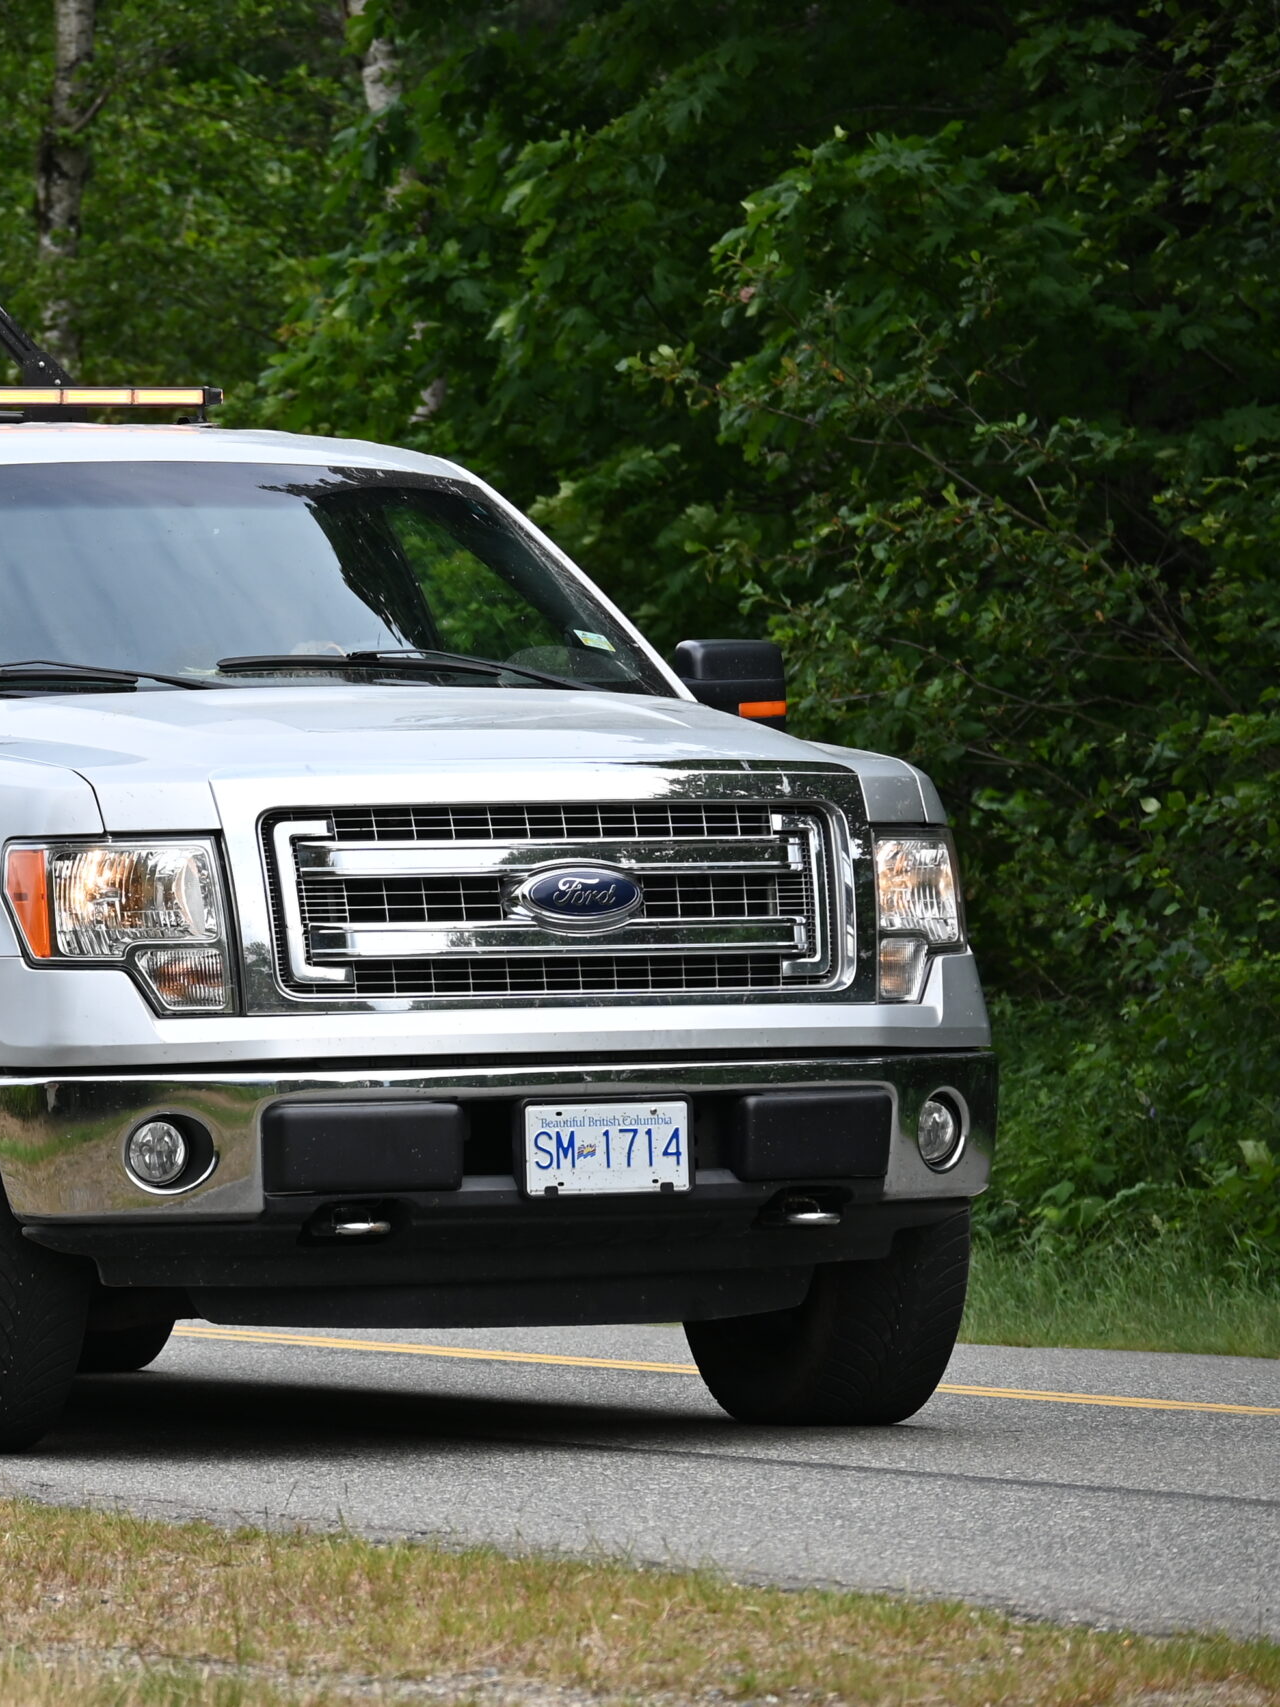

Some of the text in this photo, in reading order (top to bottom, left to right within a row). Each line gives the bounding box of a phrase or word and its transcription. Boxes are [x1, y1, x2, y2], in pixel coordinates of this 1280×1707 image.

[553, 877, 616, 905] Ford
[541, 1114, 672, 1128] Beautiful British Columbia
[534, 1127, 682, 1169] SM 1714
